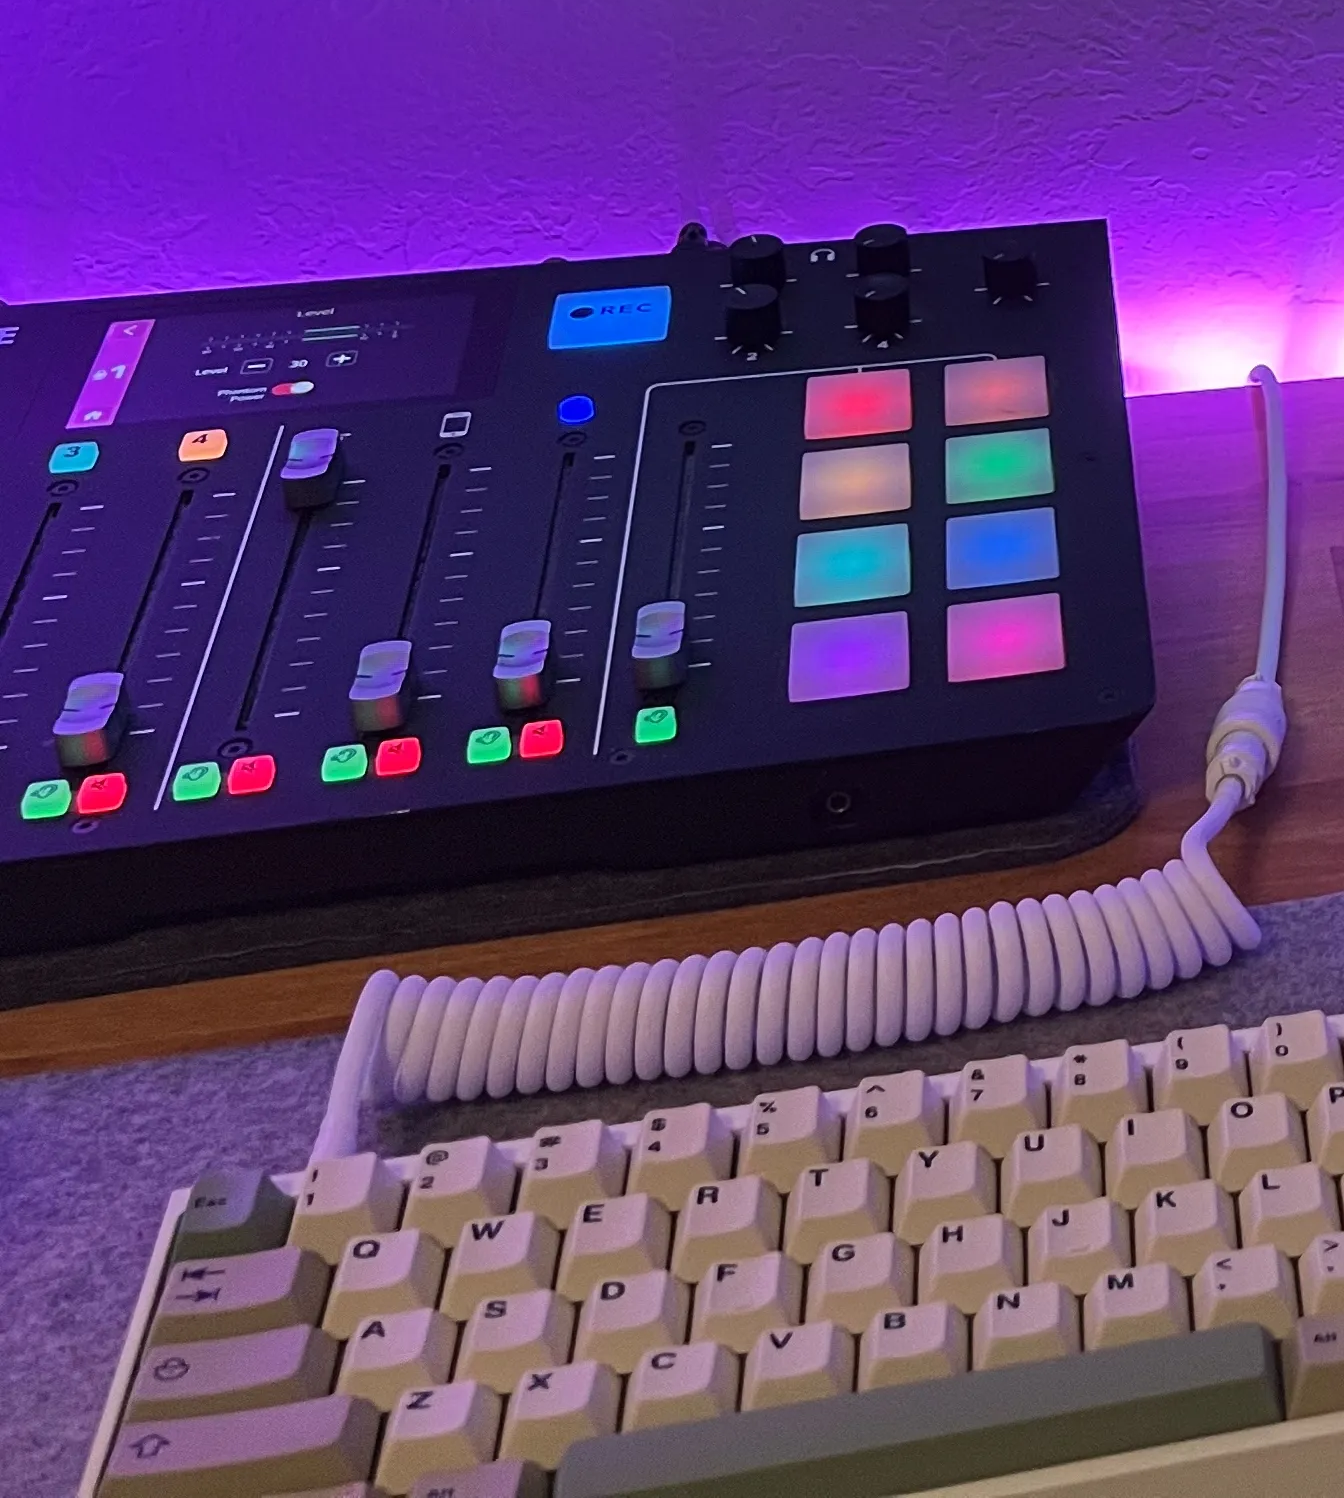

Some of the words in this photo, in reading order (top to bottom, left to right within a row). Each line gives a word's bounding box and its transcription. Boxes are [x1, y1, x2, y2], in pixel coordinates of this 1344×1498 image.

[297, 307, 335, 318] Level
[600, 303, 651, 315] REC
[876, 340, 888, 349] 4
[746, 352, 757, 360] 2
[192, 434, 208, 444] 4
[64, 446, 80, 457] 3
[1175, 1058, 1189, 1071] 9
[970, 1088, 984, 1102] 7
[864, 1105, 878, 1119] 6
[1230, 1101, 1254, 1119] O
[756, 1122, 770, 1136] 5
[1127, 1118, 1135, 1136] I
[647, 1140, 661, 1153] 4
[1023, 1133, 1045, 1152] U
[425, 1149, 449, 1166] @
[534, 1157, 549, 1171] 3
[918, 1150, 939, 1169] Y
[419, 1175, 435, 1190] 2
[808, 1168, 829, 1187] T
[1261, 1173, 1281, 1191] L
[306, 1192, 315, 1206] 1
[696, 1185, 720, 1205] R
[1155, 1190, 1177, 1209] K
[582, 1203, 605, 1224] E
[1051, 1209, 1070, 1227] J
[471, 1220, 505, 1242] W
[942, 1225, 964, 1244] H
[352, 1239, 381, 1259] Q
[831, 1243, 856, 1262] G
[716, 1263, 737, 1283] F
[1107, 1273, 1134, 1291] M
[600, 1281, 626, 1301] D
[484, 1300, 507, 1319] S
[996, 1292, 1021, 1311] N
[360, 1320, 386, 1340] A
[883, 1312, 906, 1330] B
[769, 1332, 793, 1350] V
[650, 1352, 677, 1370] C
[527, 1372, 553, 1392] X
[406, 1390, 434, 1410] Z
